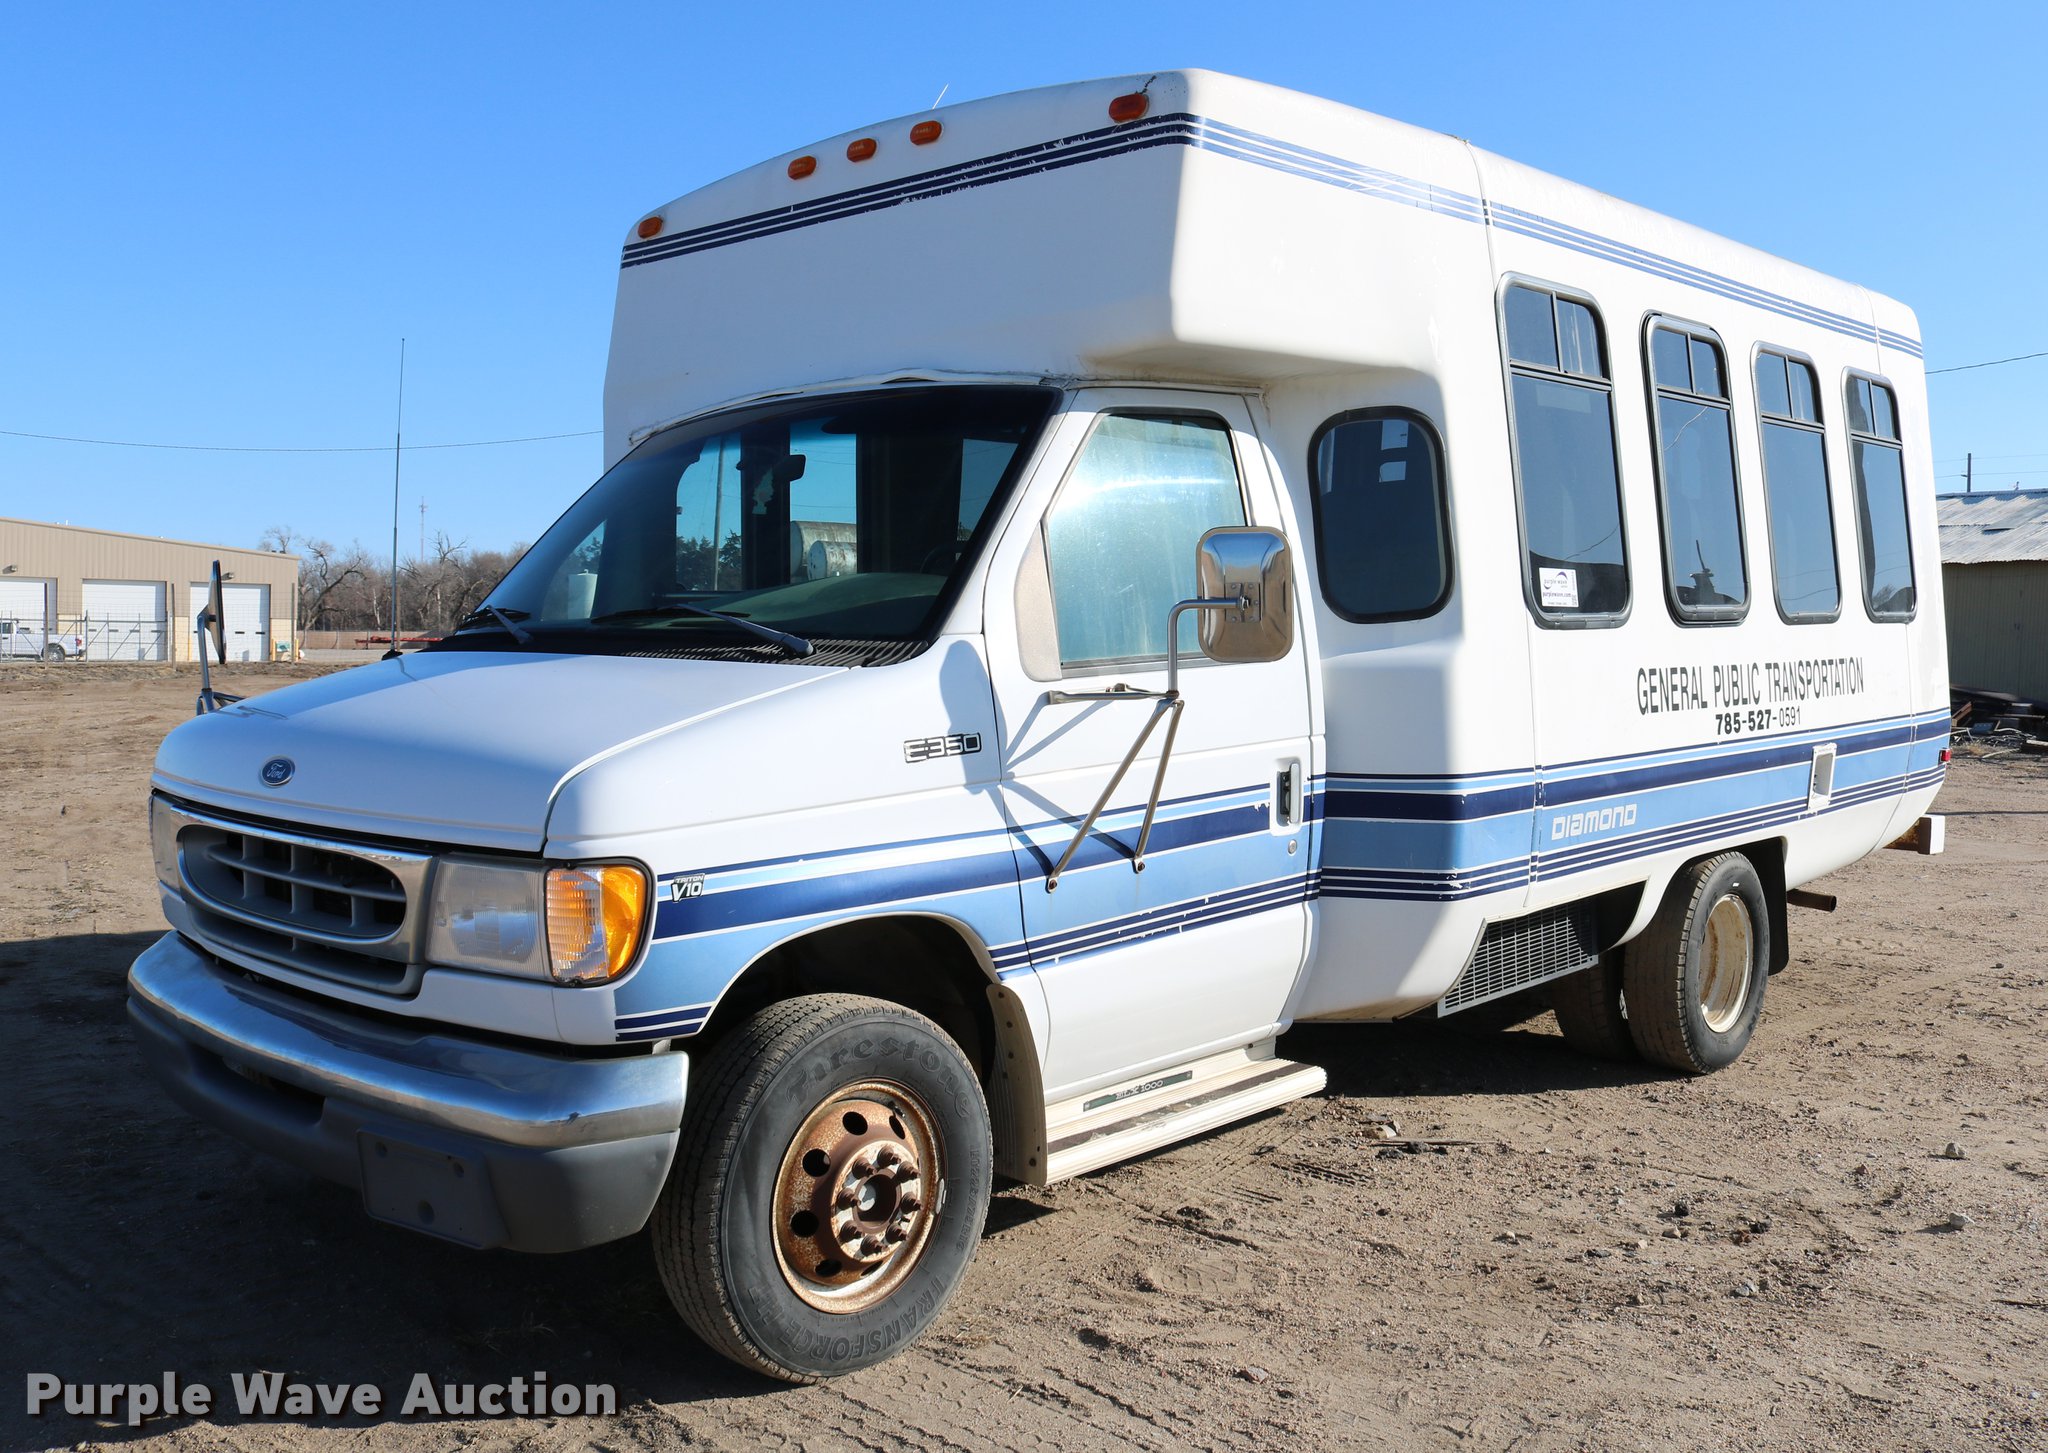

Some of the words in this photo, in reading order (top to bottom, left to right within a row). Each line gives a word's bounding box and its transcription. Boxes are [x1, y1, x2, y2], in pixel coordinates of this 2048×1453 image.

[1637, 666, 1708, 715] GENERAL
[1713, 662, 1761, 707] PUBLIC
[1765, 657, 1864, 701] TRANSPORTATION
[1715, 706, 1801, 735] 785-527-0591
[266, 763, 286, 779] Ford
[675, 874, 704, 883] TRITON
[671, 881, 703, 902] V10
[786, 1036, 972, 1118] Firestone
[1141, 1079, 1163, 1092] 1000
[778, 1275, 947, 1361] TRANSFORCE
